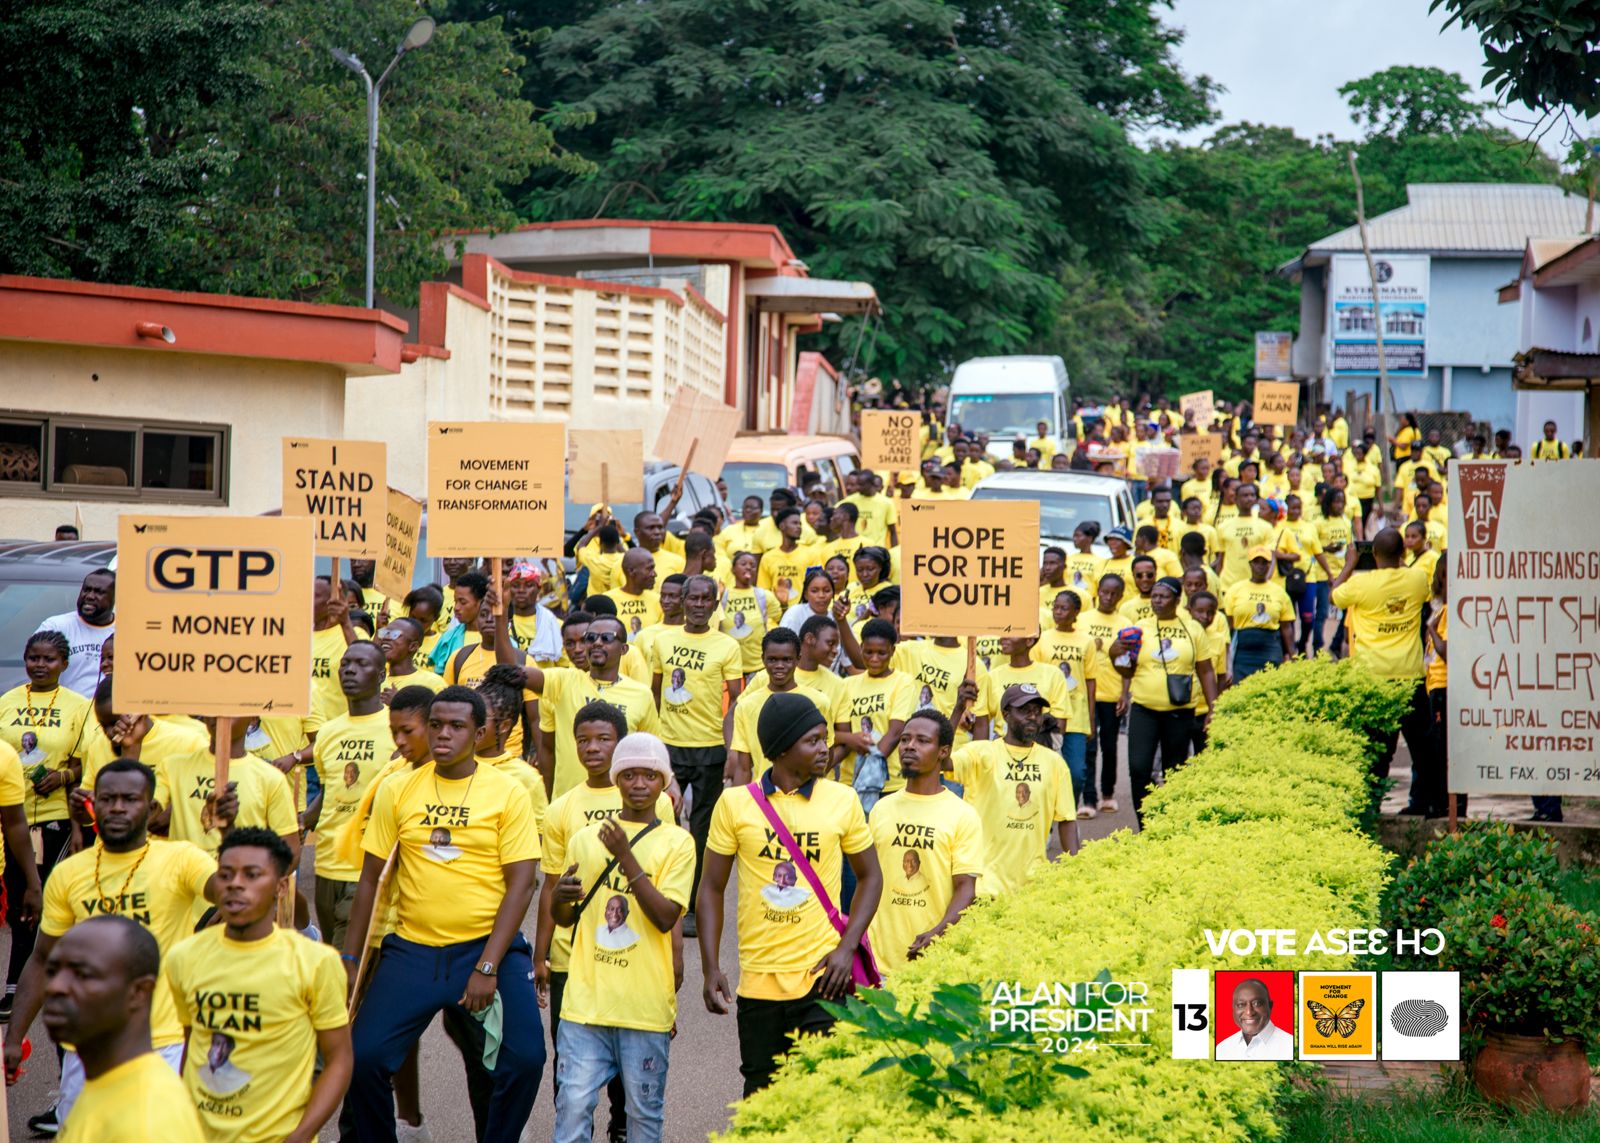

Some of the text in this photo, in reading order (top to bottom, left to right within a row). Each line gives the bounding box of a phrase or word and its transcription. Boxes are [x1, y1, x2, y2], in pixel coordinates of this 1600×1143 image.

[1260, 402, 1292, 412] ALAN
[888, 416, 913, 428] NO
[881, 429, 912, 437] MORE
[884, 438, 911, 446] LOOT
[332, 446, 337, 466] I
[889, 447, 912, 455] AND
[460, 459, 529, 471] MOVEMENT
[878, 455, 911, 464] SHARE
[295, 469, 374, 492] STAND
[446, 479, 471, 491] FOR
[475, 479, 528, 491] CHANGE
[306, 494, 362, 517] WITH
[437, 499, 548, 511] TRANSFORMATION
[315, 520, 367, 542] LAN
[932, 527, 1005, 550] HOPE
[153, 547, 275, 591] GTP
[914, 555, 1023, 579] FOR THE
[1457, 551, 1600, 580] AID TO ARTISANS G
[727, 597, 754, 606] VOTE
[924, 583, 1011, 606] YOUTH
[620, 600, 645, 608] VOTE
[621, 607, 647, 615] ALAN
[727, 604, 756, 613] ALAN
[172, 615, 256, 636] MONEY
[263, 616, 285, 636] IN
[1457, 596, 1600, 644] CRAFT SH
[673, 645, 707, 661] VOTE
[1053, 645, 1081, 653] VOTE
[135, 652, 292, 674] YOUR POCKET
[314, 658, 330, 667] TE
[665, 656, 704, 671] ALAN
[1052, 654, 1082, 662] ALAN
[312, 669, 330, 678] AN
[921, 663, 951, 682] VOTE
[915, 673, 949, 691] ALAN
[852, 693, 885, 706] VOTE
[16, 708, 61, 718] VOTE
[850, 703, 885, 717] ALAN
[10, 717, 61, 728] ALAN
[1460, 708, 1600, 730] CULTURAL CEN
[340, 740, 375, 750] VOTE
[336, 751, 374, 760] ALAN
[1006, 762, 1040, 773] VOTE
[1477, 765, 1503, 779] TEL
[1004, 772, 1042, 782] ALAN
[425, 804, 470, 818] VOTE
[896, 823, 936, 838] VOTE
[892, 835, 935, 850] ALAN
[81, 892, 146, 916] VOTE
[195, 991, 260, 1013] VOTE
[195, 1011, 262, 1033] ALAN
